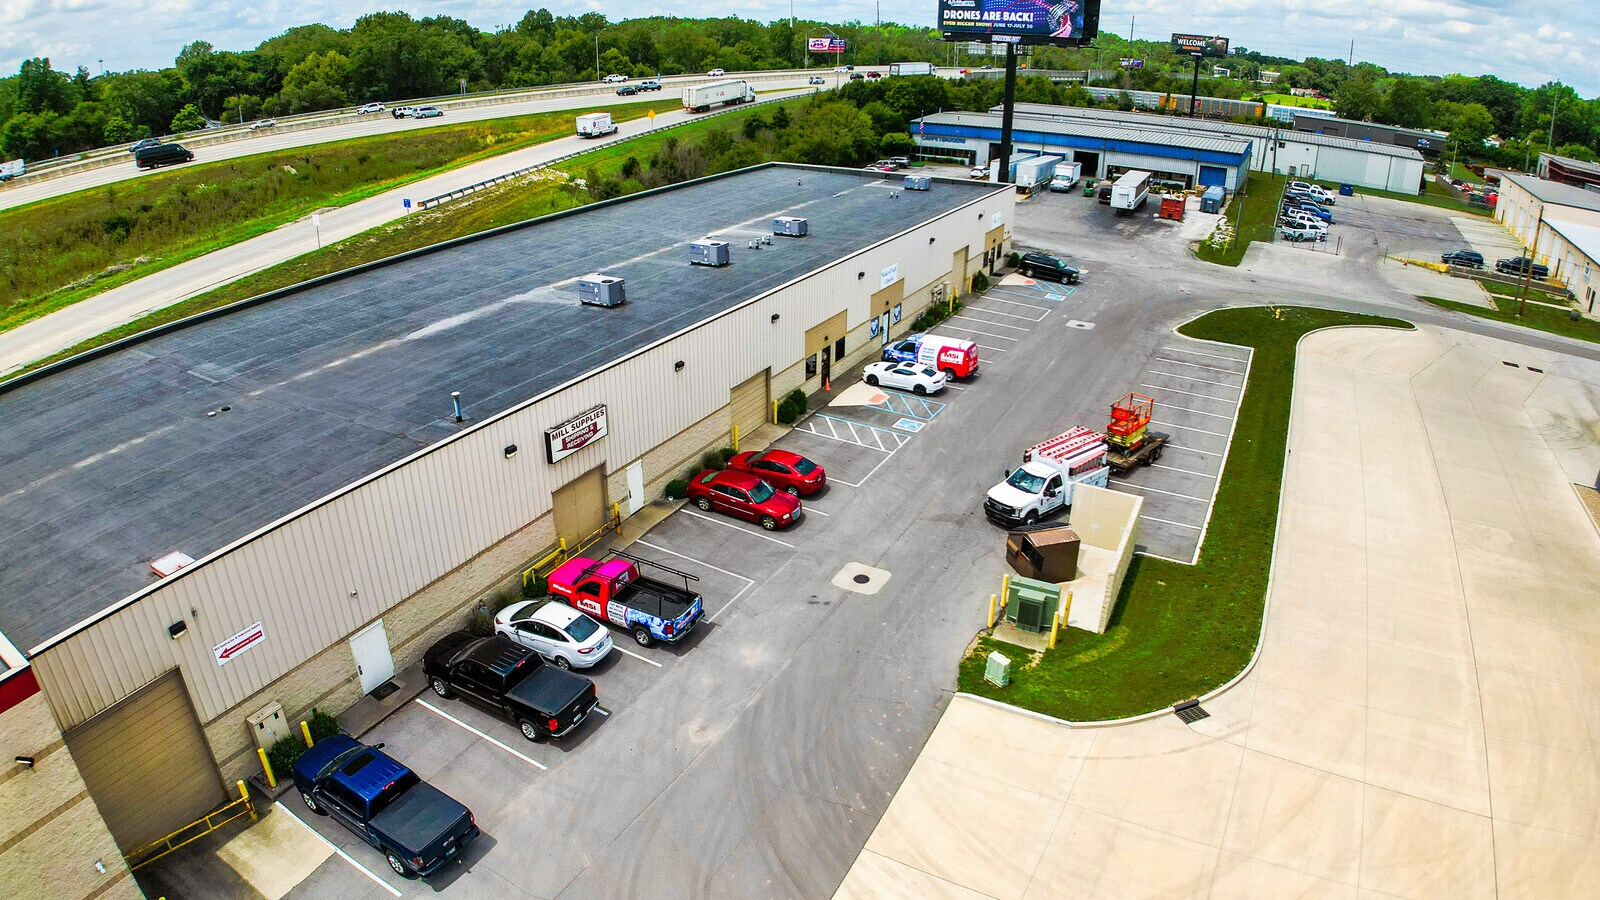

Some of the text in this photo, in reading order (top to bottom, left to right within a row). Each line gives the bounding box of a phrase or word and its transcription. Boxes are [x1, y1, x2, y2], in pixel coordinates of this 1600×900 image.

[943, 10, 1034, 22] DRONES ARE BACK!
[1178, 38, 1206, 47] WELCOME
[552, 408, 604, 441] MILL SUPPLIES
[566, 426, 590, 442] SHIPPING
[566, 431, 594, 448] RECEIVING
[580, 601, 597, 611] MSI
